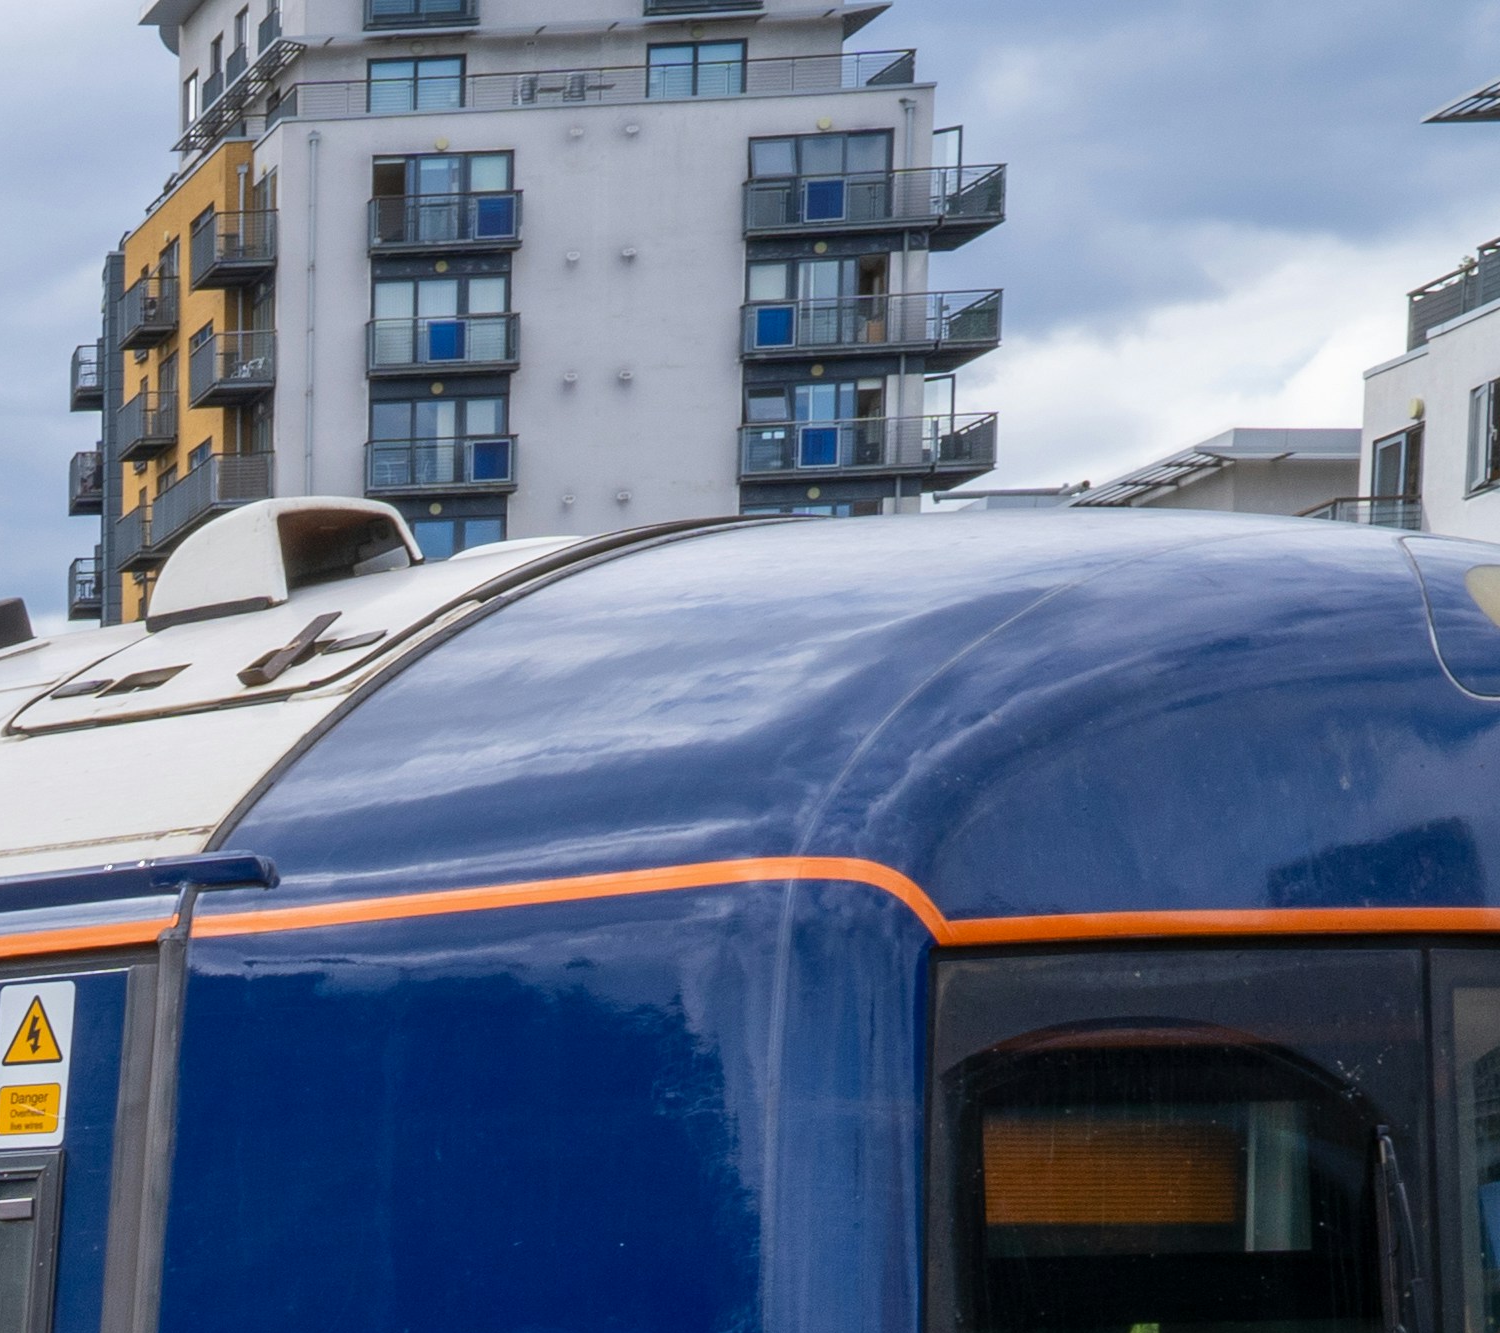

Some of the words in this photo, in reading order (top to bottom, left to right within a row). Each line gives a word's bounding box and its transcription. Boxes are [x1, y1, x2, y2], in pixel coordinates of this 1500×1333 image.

[10, 1092, 49, 1106] Danger
[9, 1121, 23, 1131] live
[24, 1121, 43, 1130] wires
